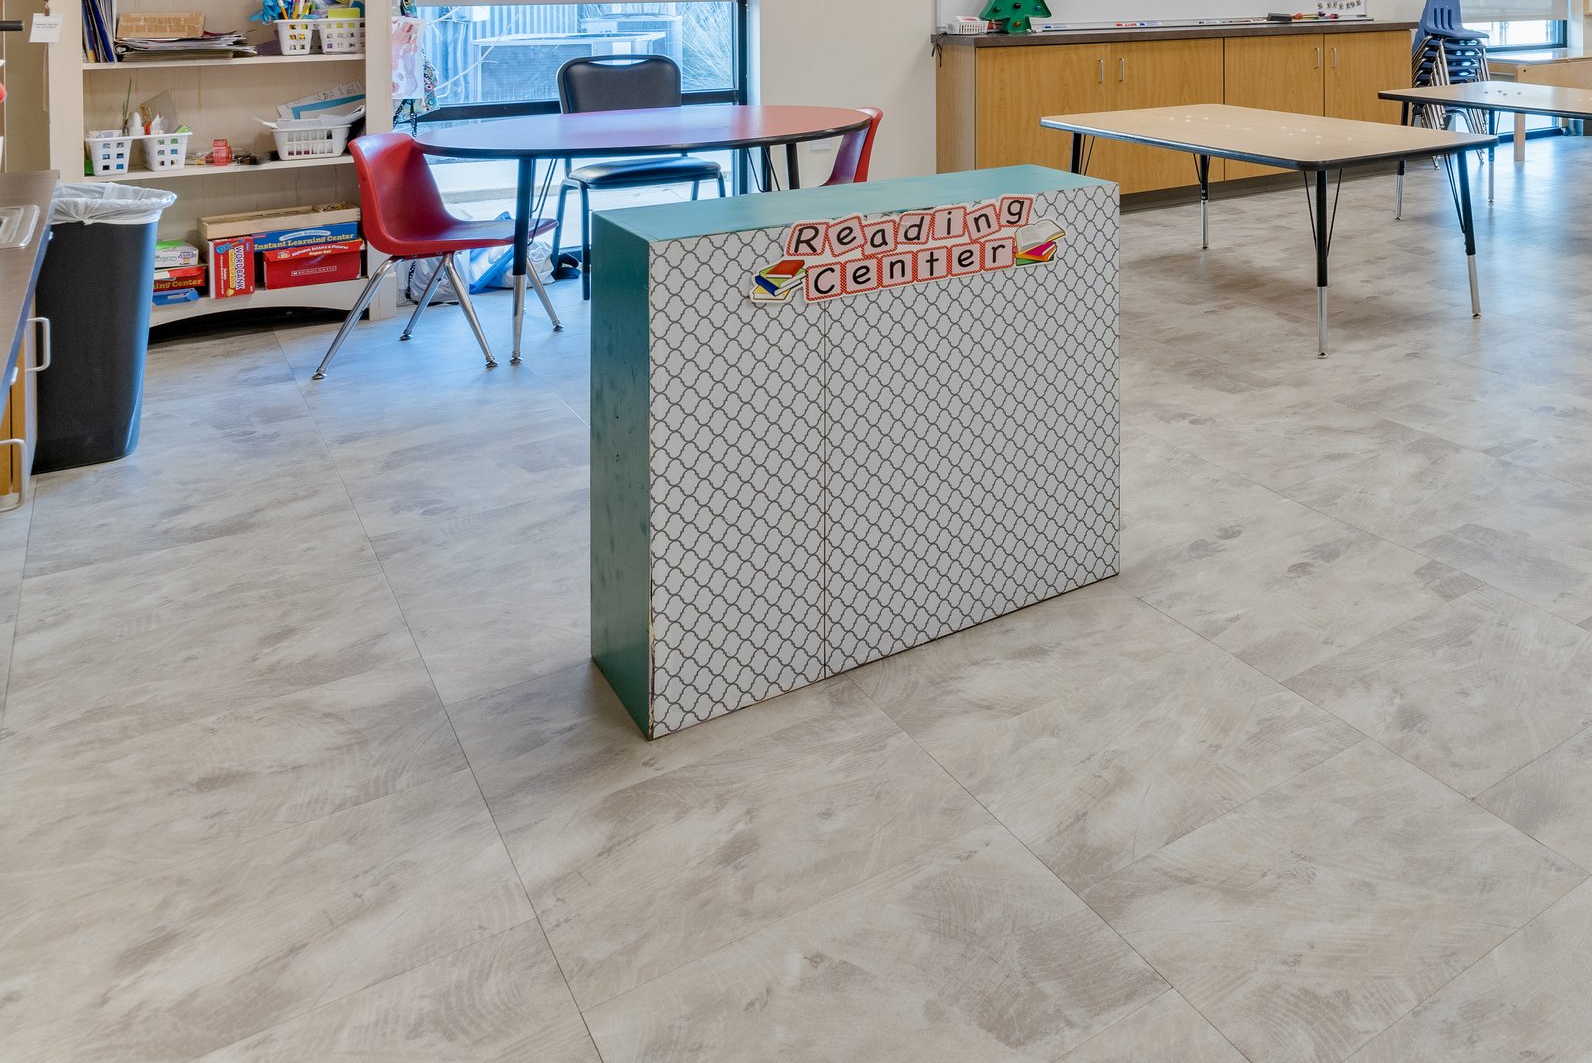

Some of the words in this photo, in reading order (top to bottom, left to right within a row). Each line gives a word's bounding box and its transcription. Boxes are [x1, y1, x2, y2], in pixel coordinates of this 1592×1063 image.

[254, 241, 287, 250] Instant
[287, 235, 326, 247] Learning
[327, 233, 355, 242] Center
[793, 200, 1025, 254] Reading
[171, 278, 203, 288] Center
[813, 242, 1006, 295] Center
